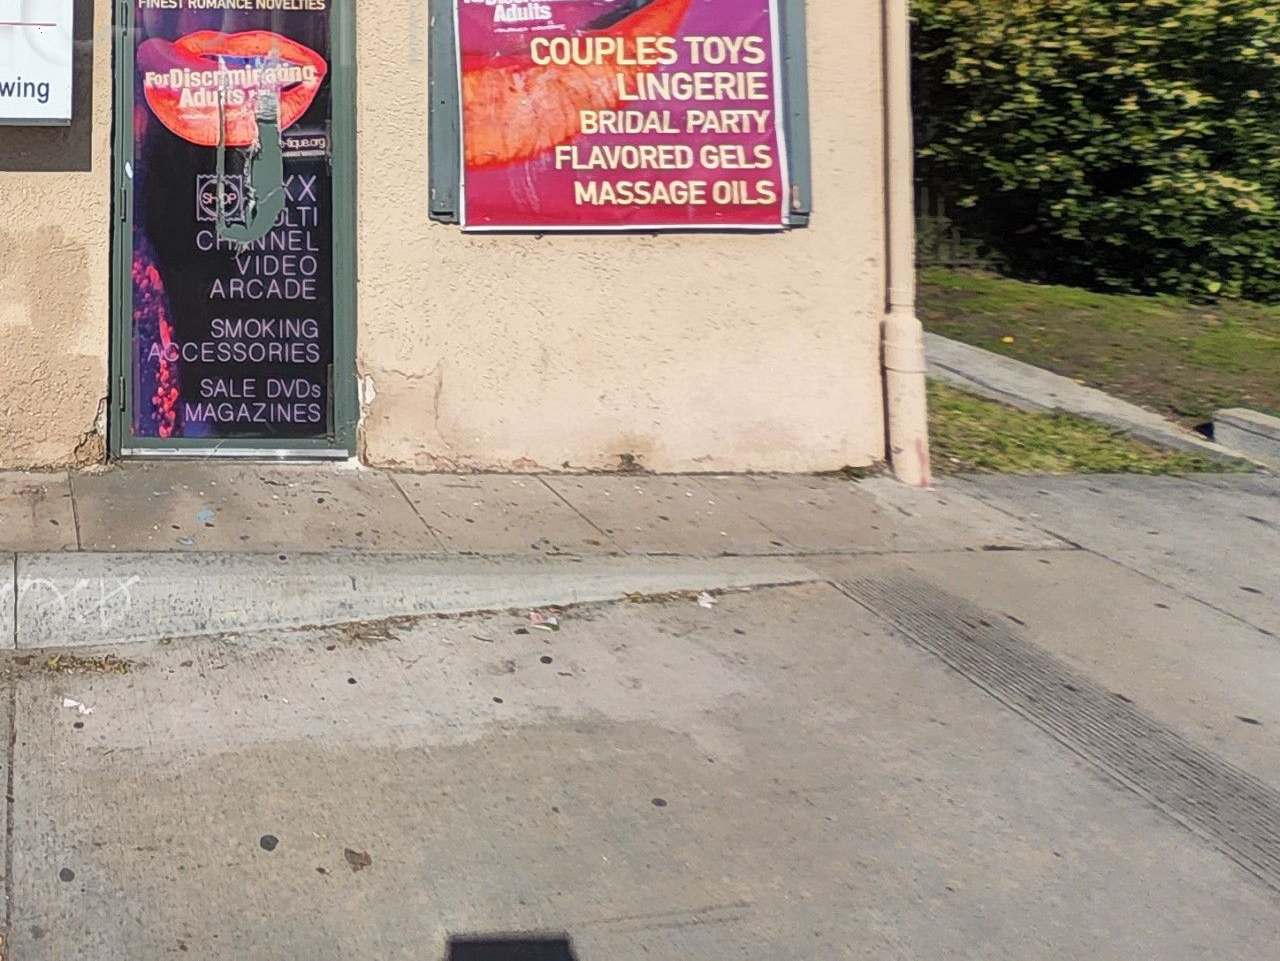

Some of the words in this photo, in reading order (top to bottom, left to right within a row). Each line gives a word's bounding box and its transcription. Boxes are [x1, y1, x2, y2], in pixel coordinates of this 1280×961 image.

[493, 3, 552, 22] Adults
[530, 36, 678, 65] COUPLES
[683, 36, 765, 65] TOYS
[616, 72, 768, 100] LINGERIE
[179, 87, 244, 108] Aduts
[580, 110, 680, 134] BRIDAL
[686, 109, 771, 134] PARTY
[555, 145, 694, 170] FLAVORED
[699, 145, 773, 170] GELS
[574, 181, 707, 205] MASSAGE
[712, 180, 776, 205] OILS
[236, 254, 318, 276] VIDEO
[209, 278, 317, 300] ARCADE
[210, 318, 319, 339] SMOKING
[147, 342, 320, 363] ACCESSORIES
[200, 378, 256, 399] SALE
[266, 379, 321, 399] DVDs
[185, 403, 321, 423] MAGAZINES
